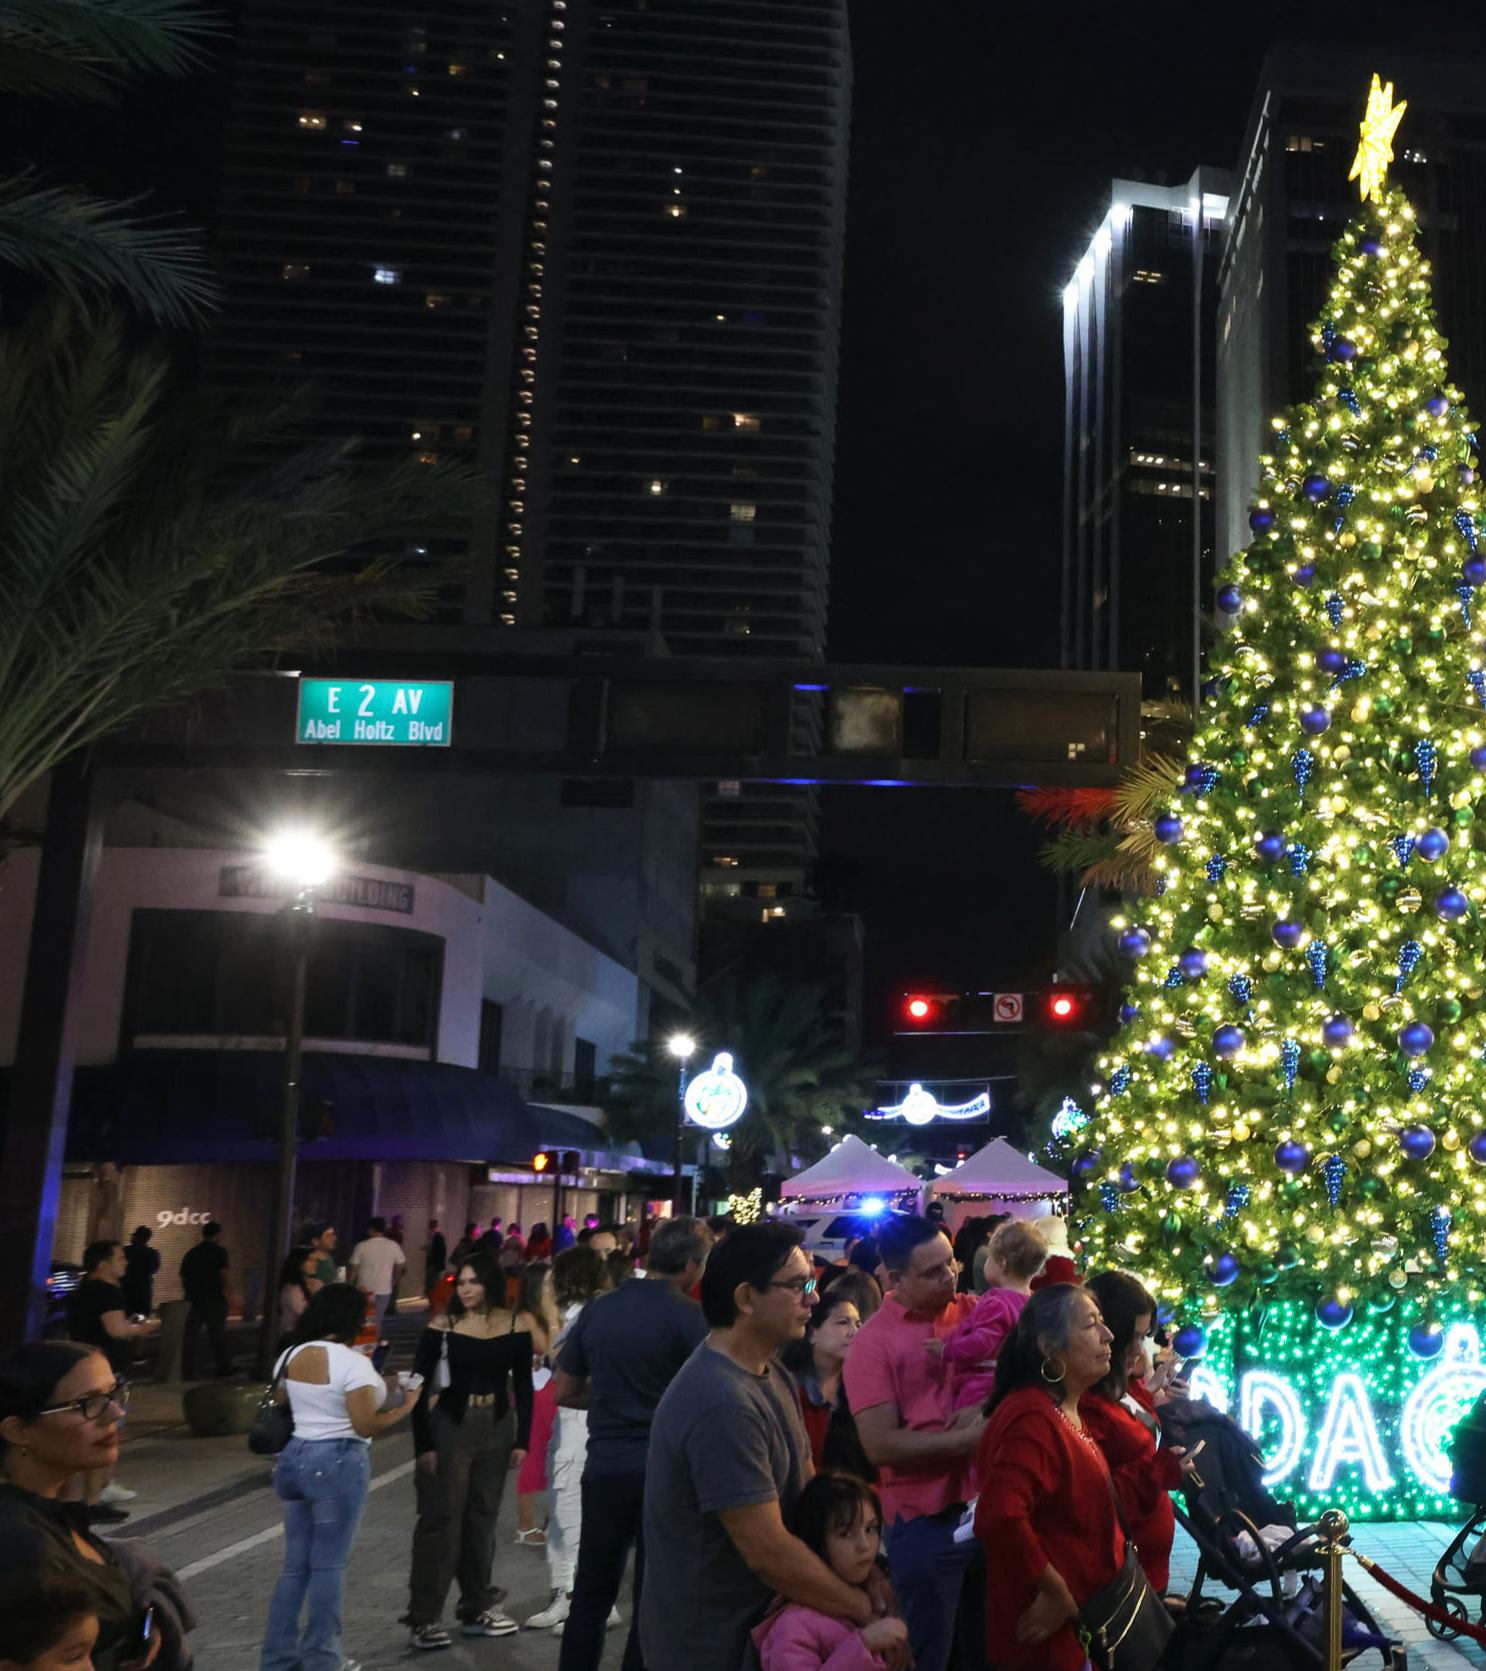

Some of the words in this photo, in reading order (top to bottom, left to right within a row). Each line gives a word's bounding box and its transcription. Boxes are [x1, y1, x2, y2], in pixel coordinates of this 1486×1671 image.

[328, 687, 341, 713] E
[357, 684, 376, 717] 2
[392, 688, 423, 715] AV
[304, 719, 341, 739] Abel
[354, 720, 395, 740] Holtz
[408, 721, 443, 741] Blvd
